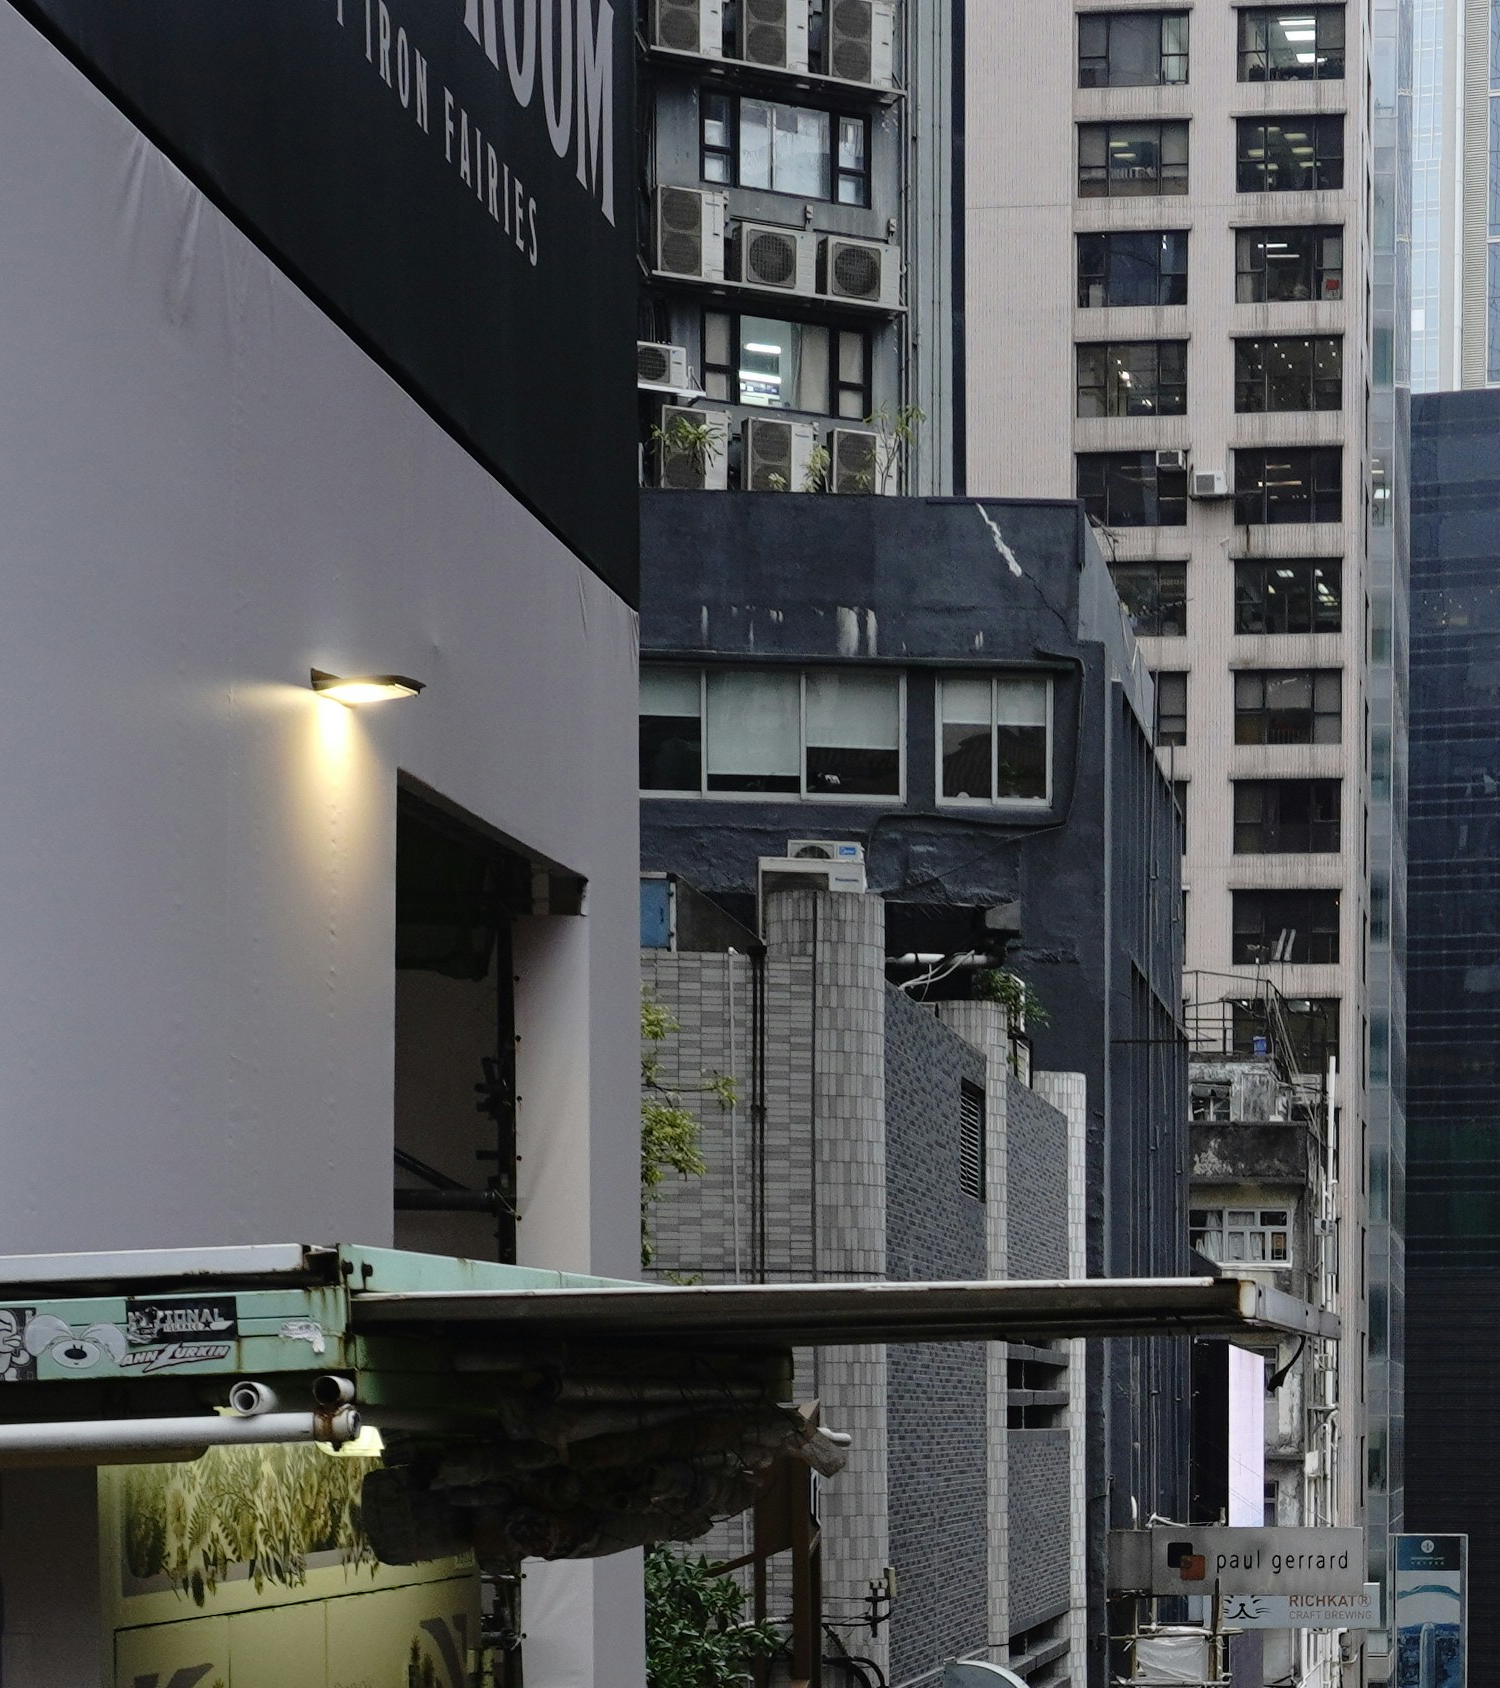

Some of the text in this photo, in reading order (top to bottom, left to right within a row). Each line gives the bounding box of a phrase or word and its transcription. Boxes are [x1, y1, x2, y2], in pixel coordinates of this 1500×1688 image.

[444, 87, 539, 268] FAIRIES
[1216, 1549, 1349, 1575] paul gerrard
[1289, 1610, 1372, 1620] CRAFT BREWING
